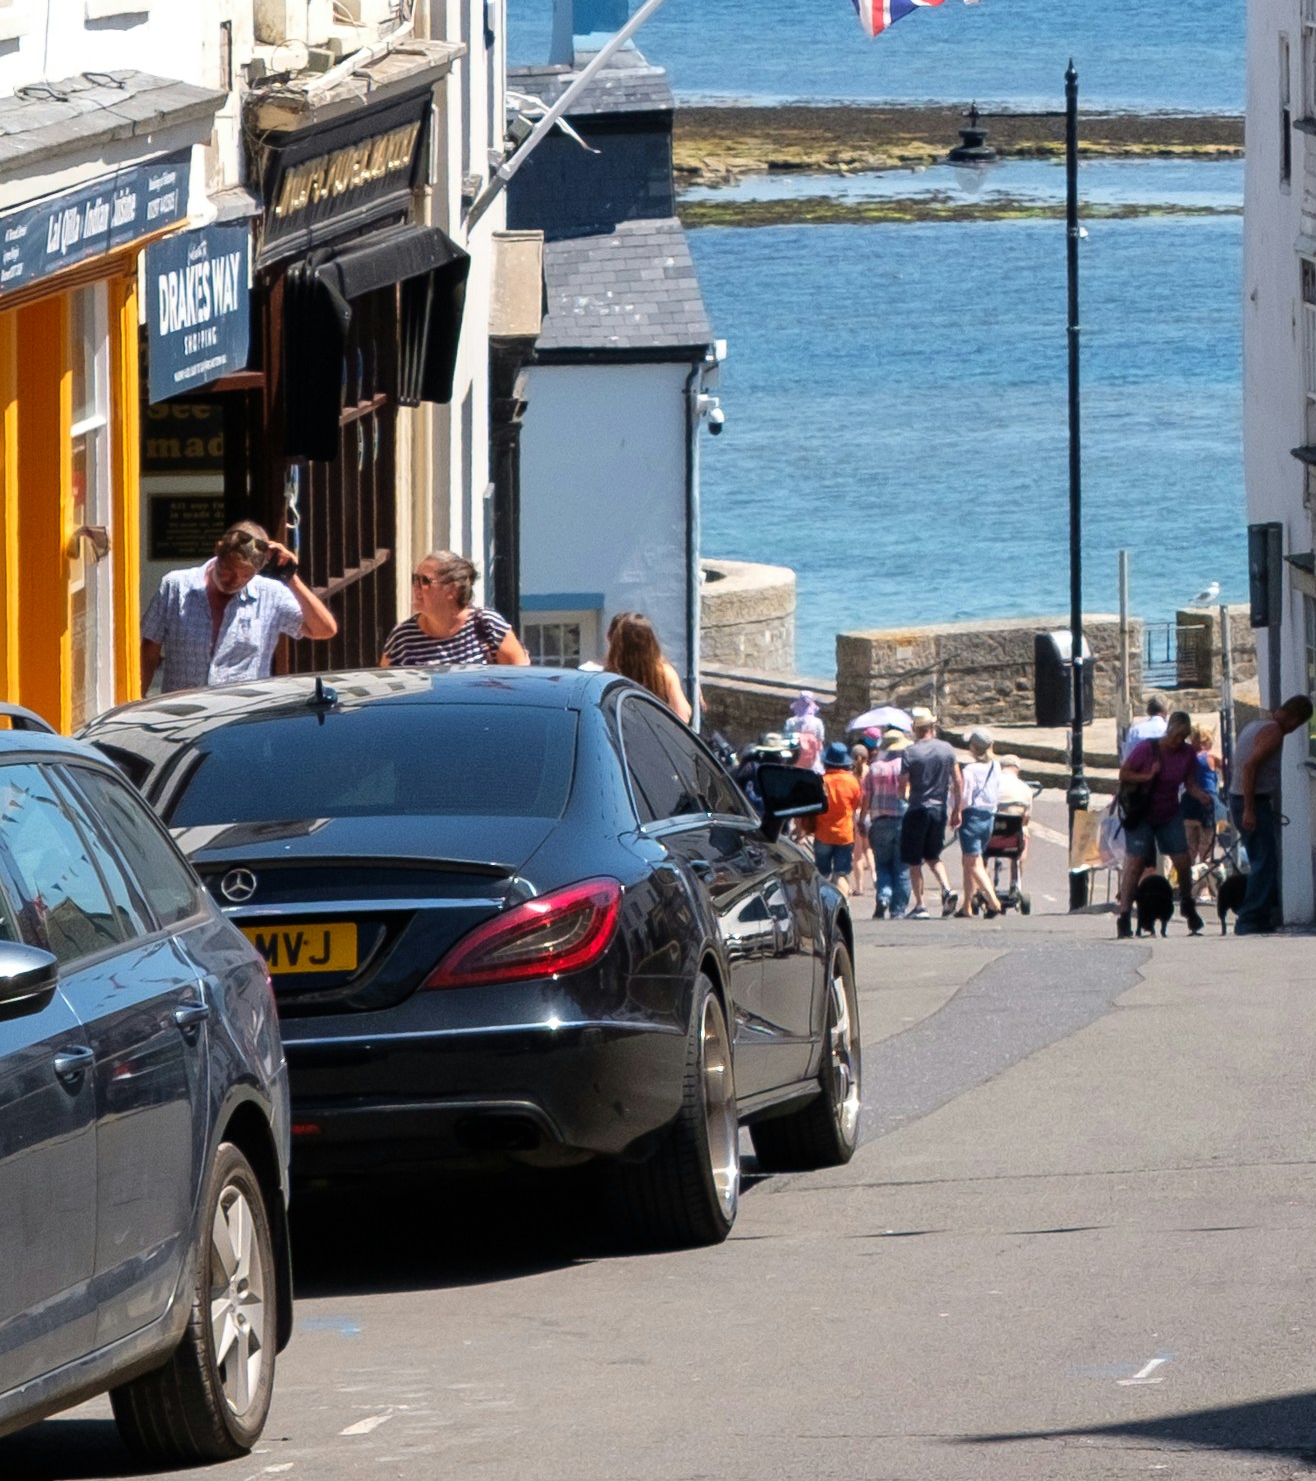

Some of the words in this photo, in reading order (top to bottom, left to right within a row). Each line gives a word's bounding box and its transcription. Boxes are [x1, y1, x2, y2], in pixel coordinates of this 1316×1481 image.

[158, 260, 211, 337] DRAKES
[211, 251, 241, 318] WAY
[255, 930, 332, 968] MVJ
